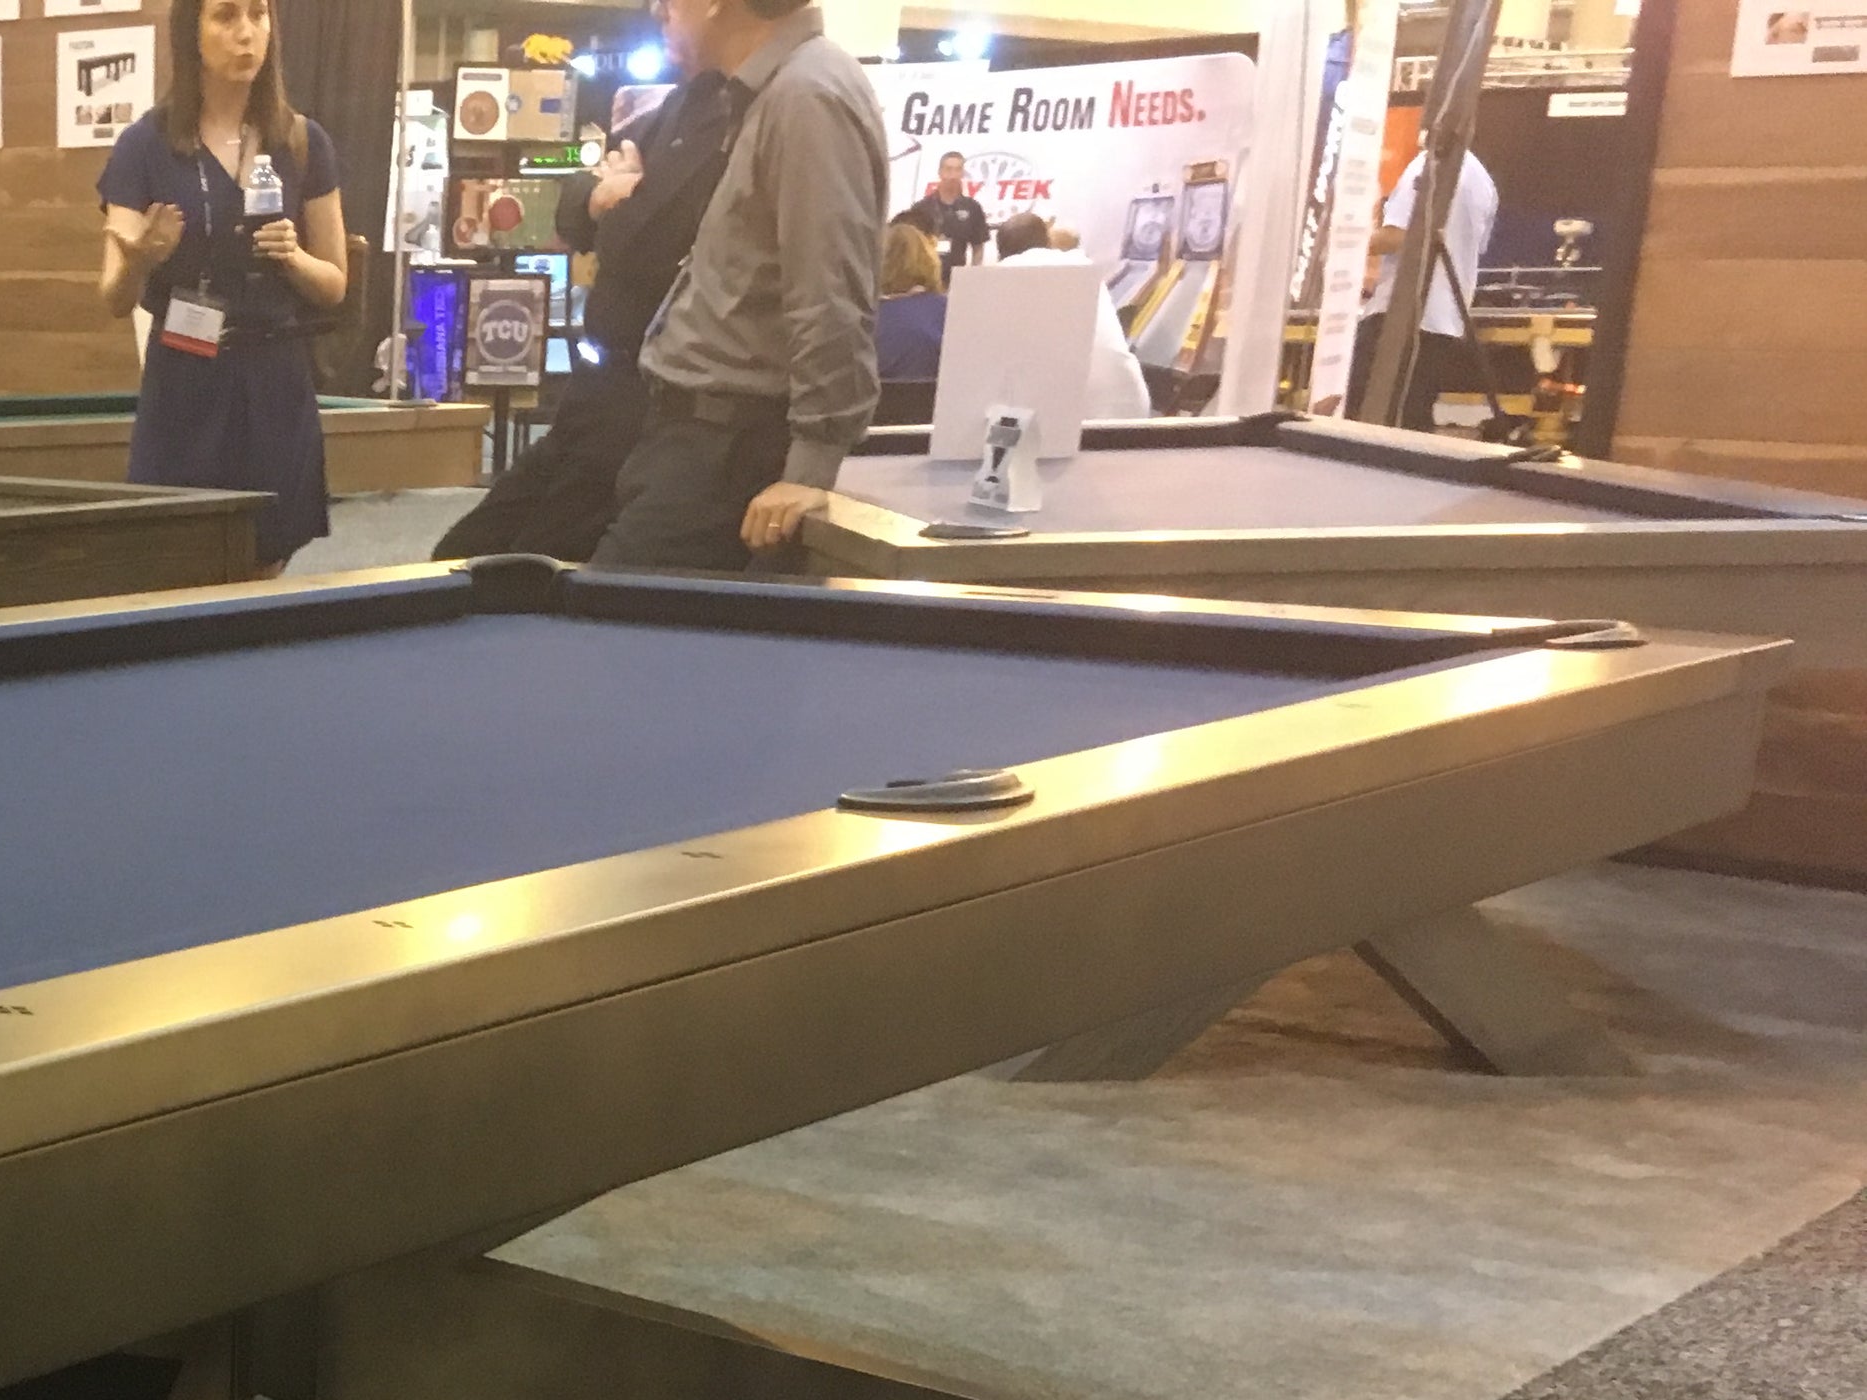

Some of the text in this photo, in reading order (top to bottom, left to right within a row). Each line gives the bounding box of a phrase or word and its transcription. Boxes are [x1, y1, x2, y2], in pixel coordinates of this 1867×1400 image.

[901, 80, 1207, 136] GAME ROOM NEEDS.
[997, 178, 1054, 201] TEK
[482, 319, 529, 344] TCU
